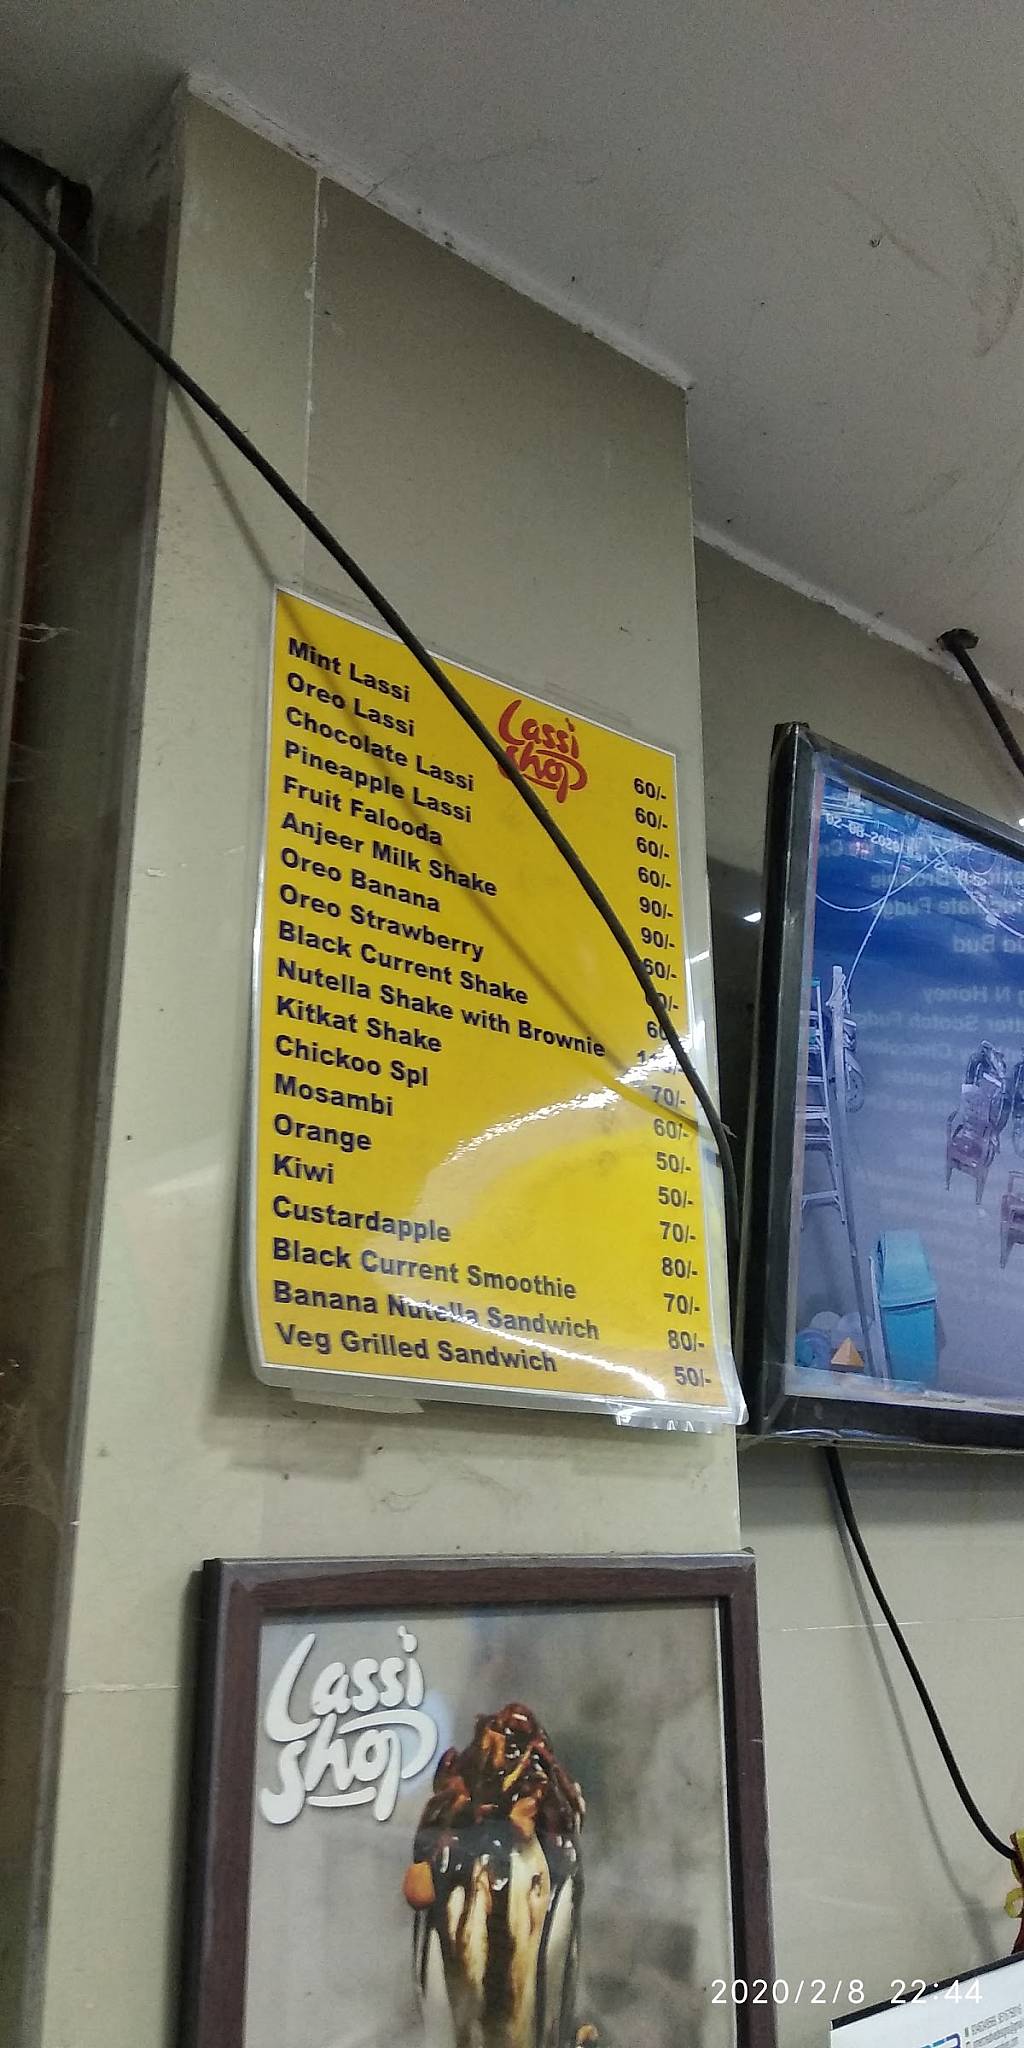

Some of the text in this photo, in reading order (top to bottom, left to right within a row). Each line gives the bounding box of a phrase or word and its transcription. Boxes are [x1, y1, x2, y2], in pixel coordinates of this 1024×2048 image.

[287, 672, 668, 830] Oreo Lassi 60/-
[288, 637, 667, 801] Mint Lassi 60/-
[499, 699, 579, 759] Lassi
[285, 739, 672, 889] Pineapple Lassi 60/-
[286, 706, 670, 860] Chocolate Lassi 60/-
[281, 847, 342, 882] Oreo
[351, 868, 440, 913] Banana
[281, 811, 675, 950] Anjeer Milk Shake 90/-
[284, 775, 674, 920] Fruit Falooda 90/-
[279, 883, 342, 918] Oreo
[350, 904, 484, 963] Strawberry
[279, 919, 353, 957] Black
[360, 944, 452, 985] Current
[460, 970, 529, 1005] Shake
[277, 995, 686, 1109] Kitkat Shake 70/-
[278, 957, 371, 999] Nutella
[379, 984, 454, 1020] Shake
[460, 1009, 510, 1034] with
[518, 1019, 606, 1057] Brownie
[275, 1034, 689, 1141] Chickoo Spl 60/-
[275, 1072, 692, 1175] Mosambi 50/-
[273, 1153, 696, 1244] Kiwi 70/-
[274, 1113, 694, 1209] Orange 50/-
[272, 1195, 698, 1279] Custardapple 80/-
[273, 1237, 700, 1315] Black Current Smoothie 70/-
[273, 1279, 705, 1352] Banana Nutella Sandwich 80/-
[274, 1322, 712, 1387] Veg Grilled Sandwich 50/-
[264, 1625, 426, 1743] Lassi
